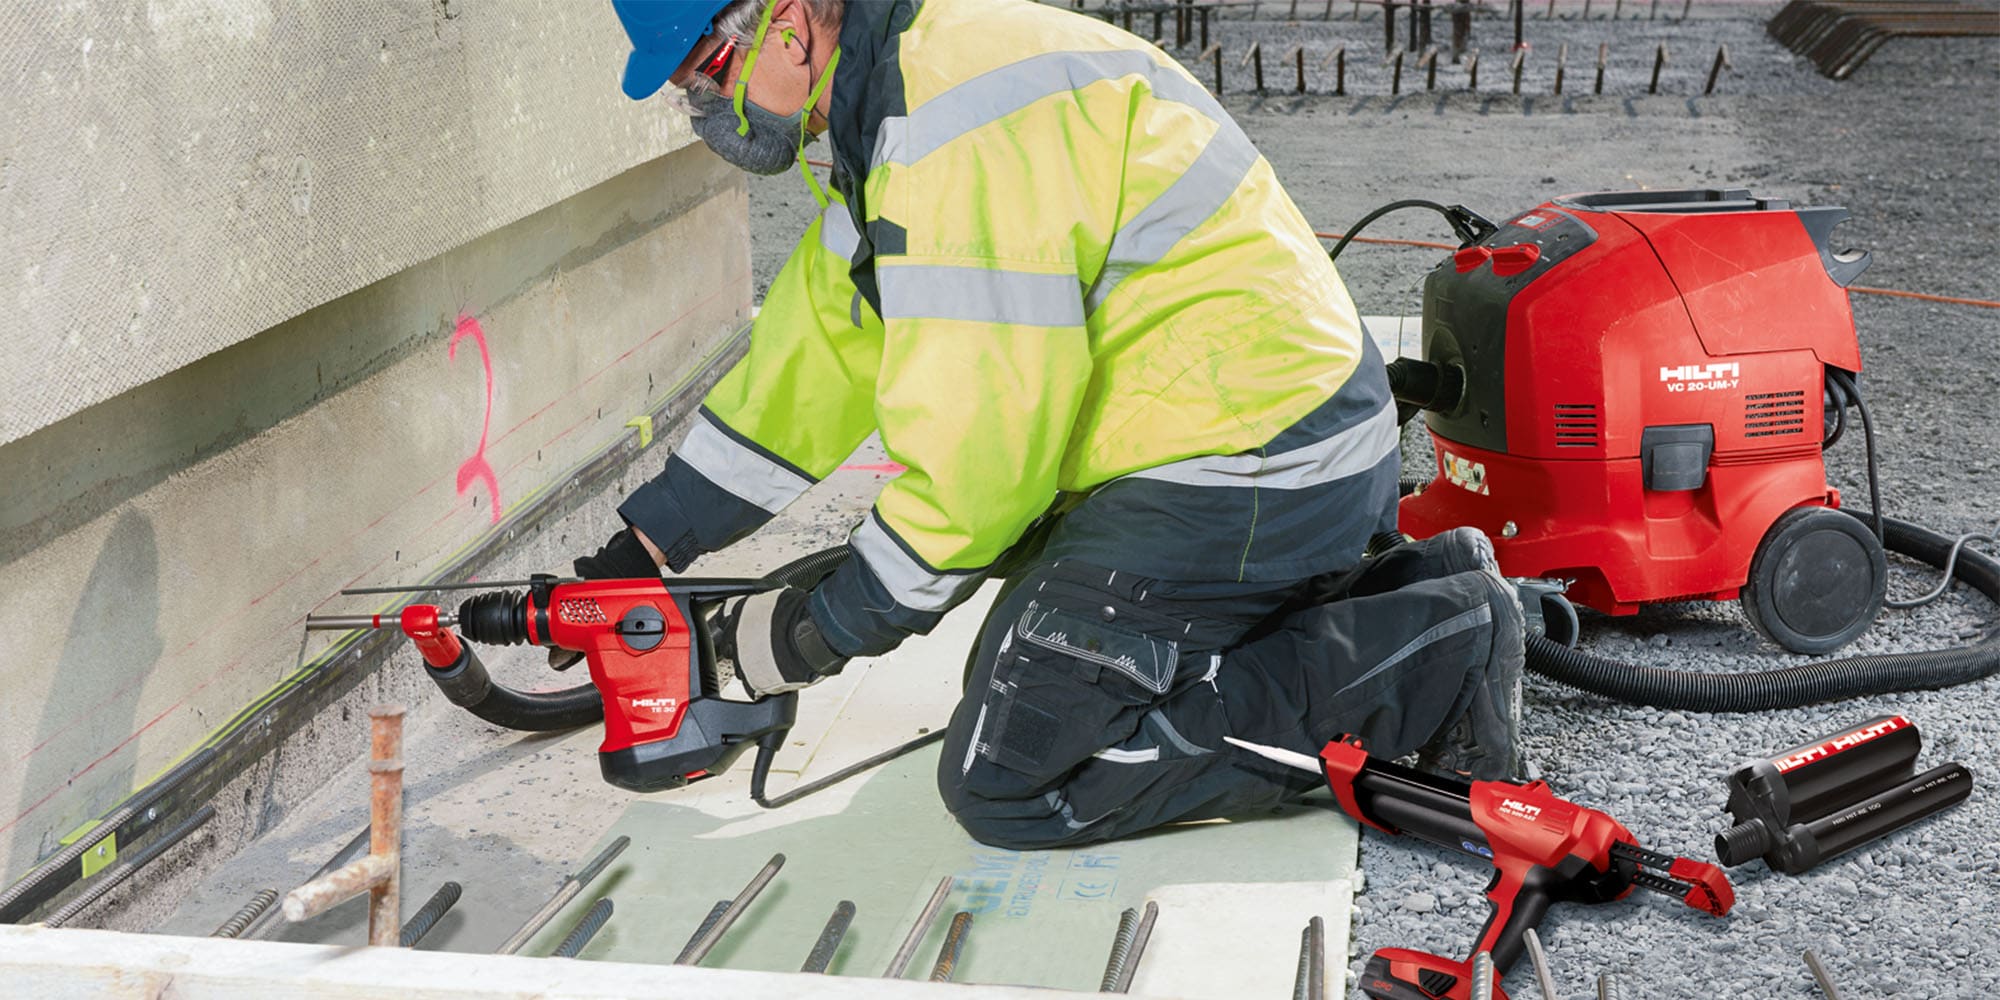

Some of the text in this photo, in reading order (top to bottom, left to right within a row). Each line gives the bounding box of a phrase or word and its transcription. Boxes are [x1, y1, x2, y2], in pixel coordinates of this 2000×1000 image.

[1660, 362, 1740, 382] HILTI
[1667, 379, 1740, 393] VC 20-UM-Y
[632, 697, 676, 708] HILTI
[650, 706, 676, 714] TE 30
[1831, 720, 1897, 751] HILTI
[1502, 798, 1541, 817] HILTI
